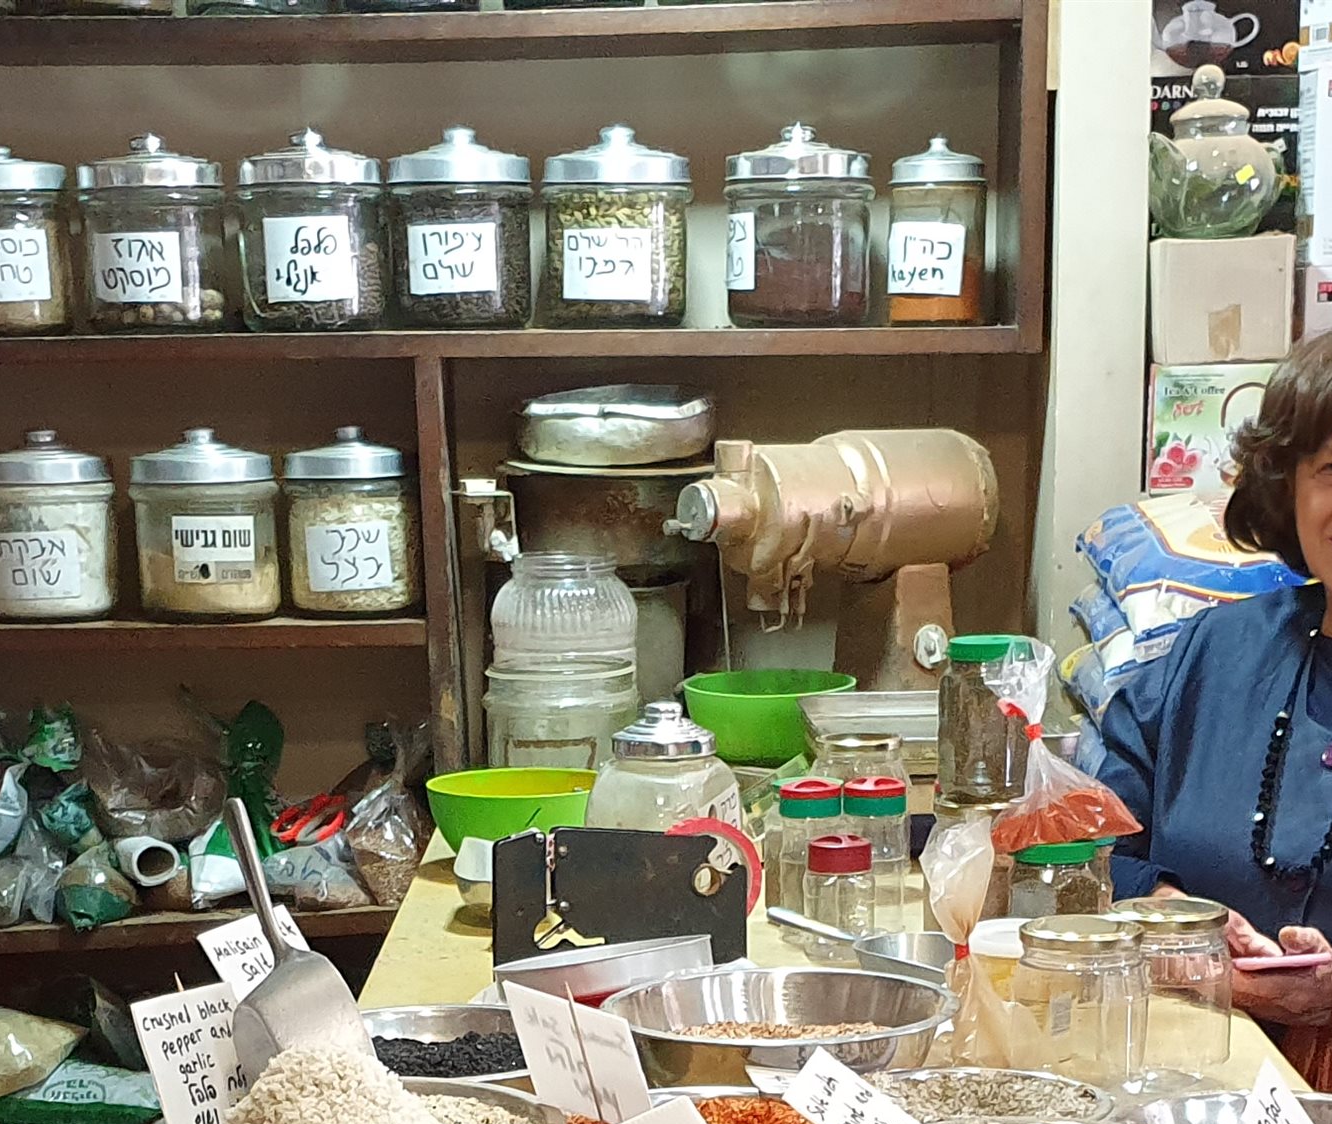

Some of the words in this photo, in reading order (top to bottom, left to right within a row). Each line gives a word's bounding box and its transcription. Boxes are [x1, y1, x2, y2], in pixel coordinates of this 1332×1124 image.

[1151, 85, 1197, 99] DARN
[111, 238, 166, 263] אגוז
[290, 226, 337, 255] פלפל
[567, 232, 608, 251] שלם
[101, 266, 171, 294] מוסקט
[422, 260, 474, 280] שלם
[175, 529, 217, 548] גבישי
[222, 529, 251, 548] שום
[12, 568, 62, 586] שום
[321, 555, 383, 587] בצל
[196, 998, 233, 1021] black
[161, 1029, 203, 1061] pepper
[211, 1020, 233, 1039] and
[179, 1053, 216, 1084] garlic
